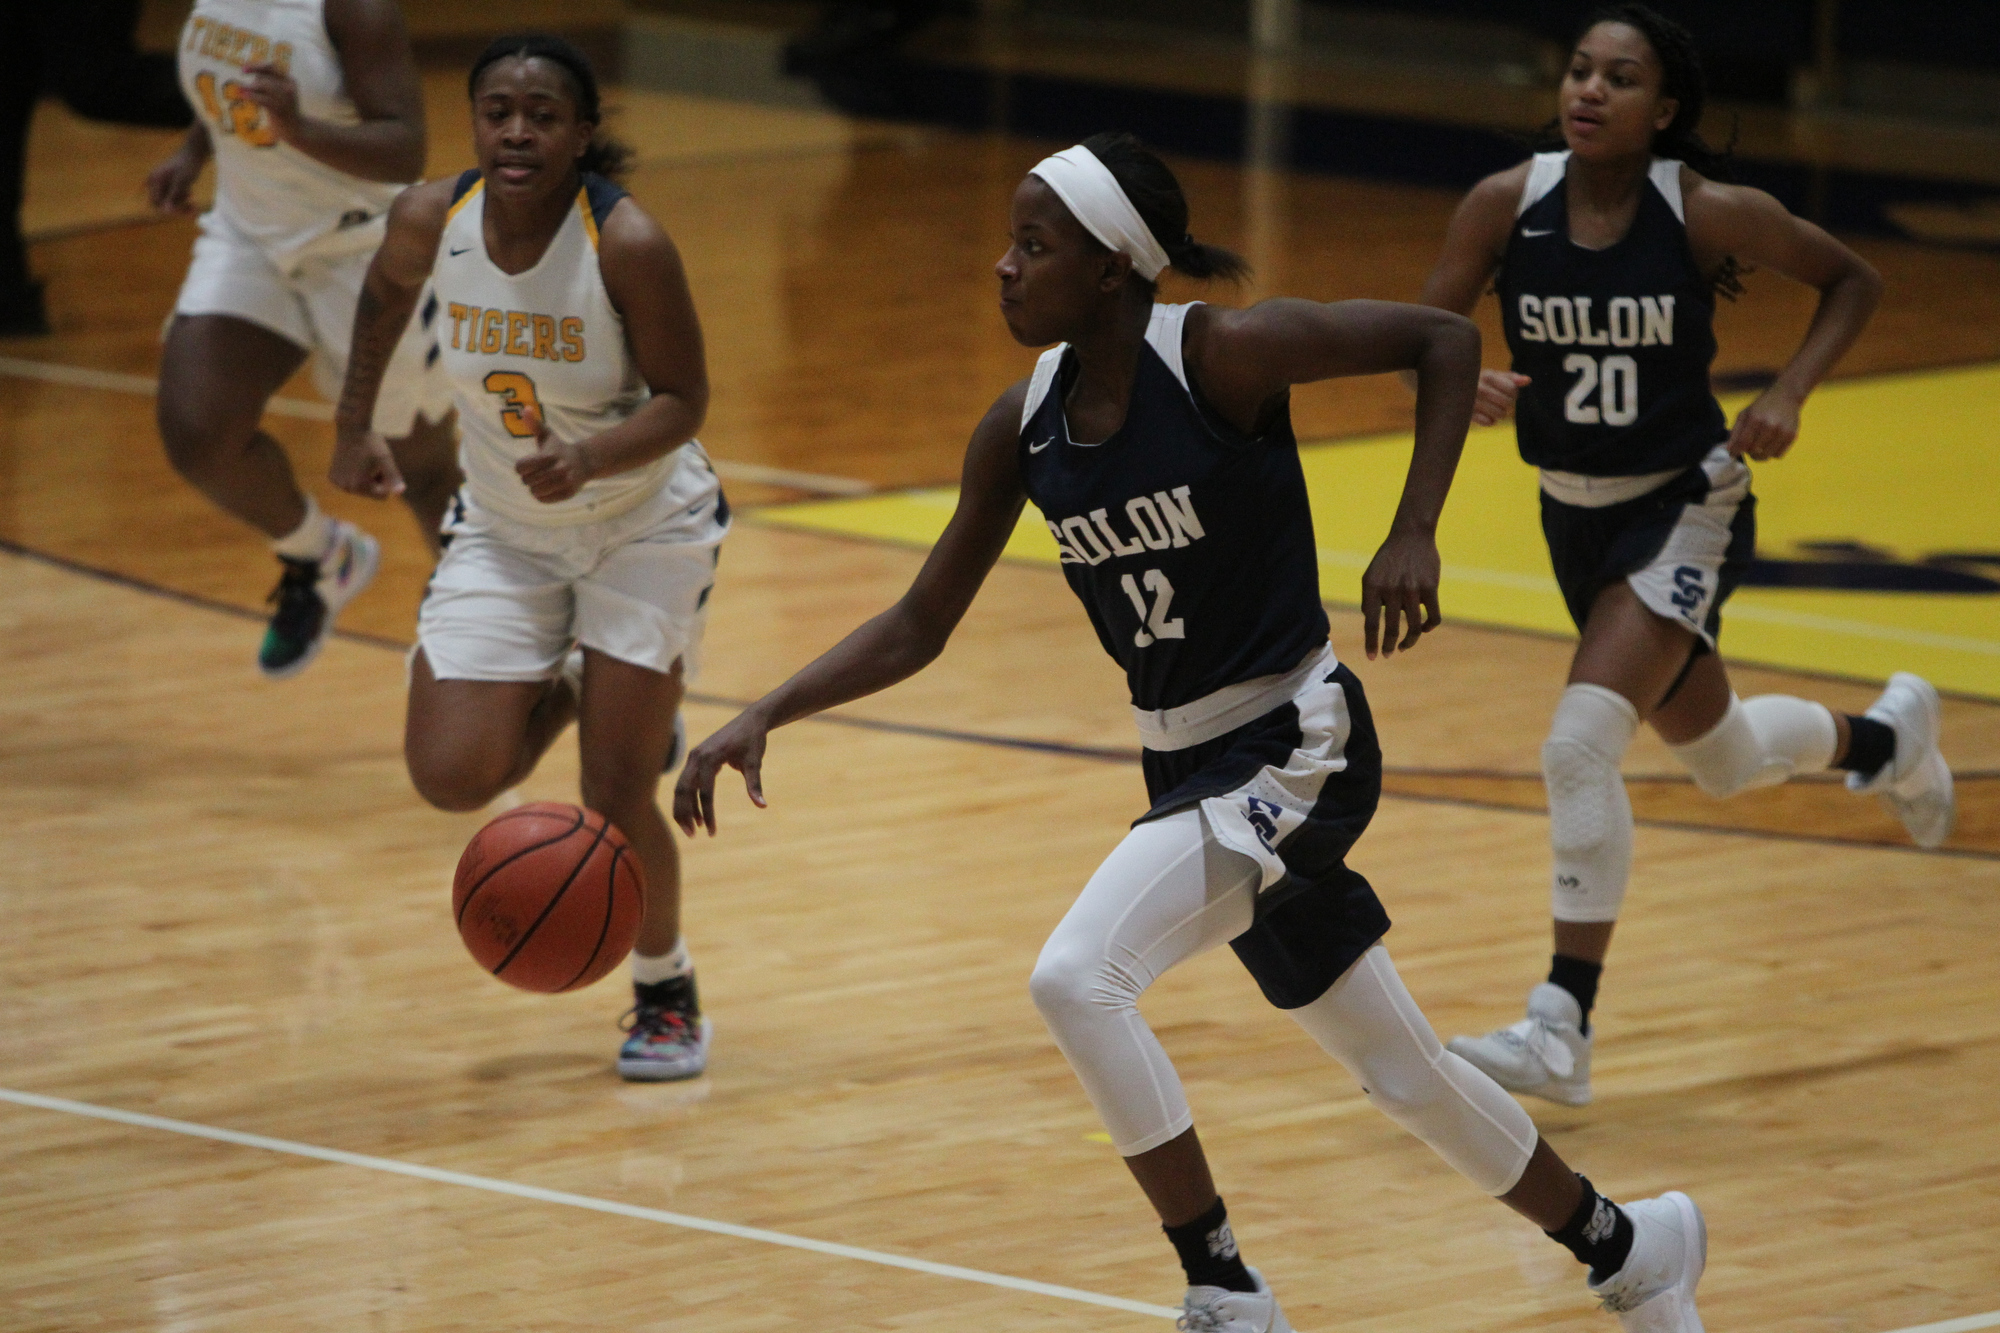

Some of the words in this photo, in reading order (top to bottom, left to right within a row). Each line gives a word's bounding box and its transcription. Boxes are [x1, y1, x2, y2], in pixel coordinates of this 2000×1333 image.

[448, 301, 585, 362] TIGERS
[1518, 294, 1675, 347] SOLON
[483, 369, 546, 439] 3
[1562, 353, 1639, 427] 20
[1120, 568, 1186, 648] 12
